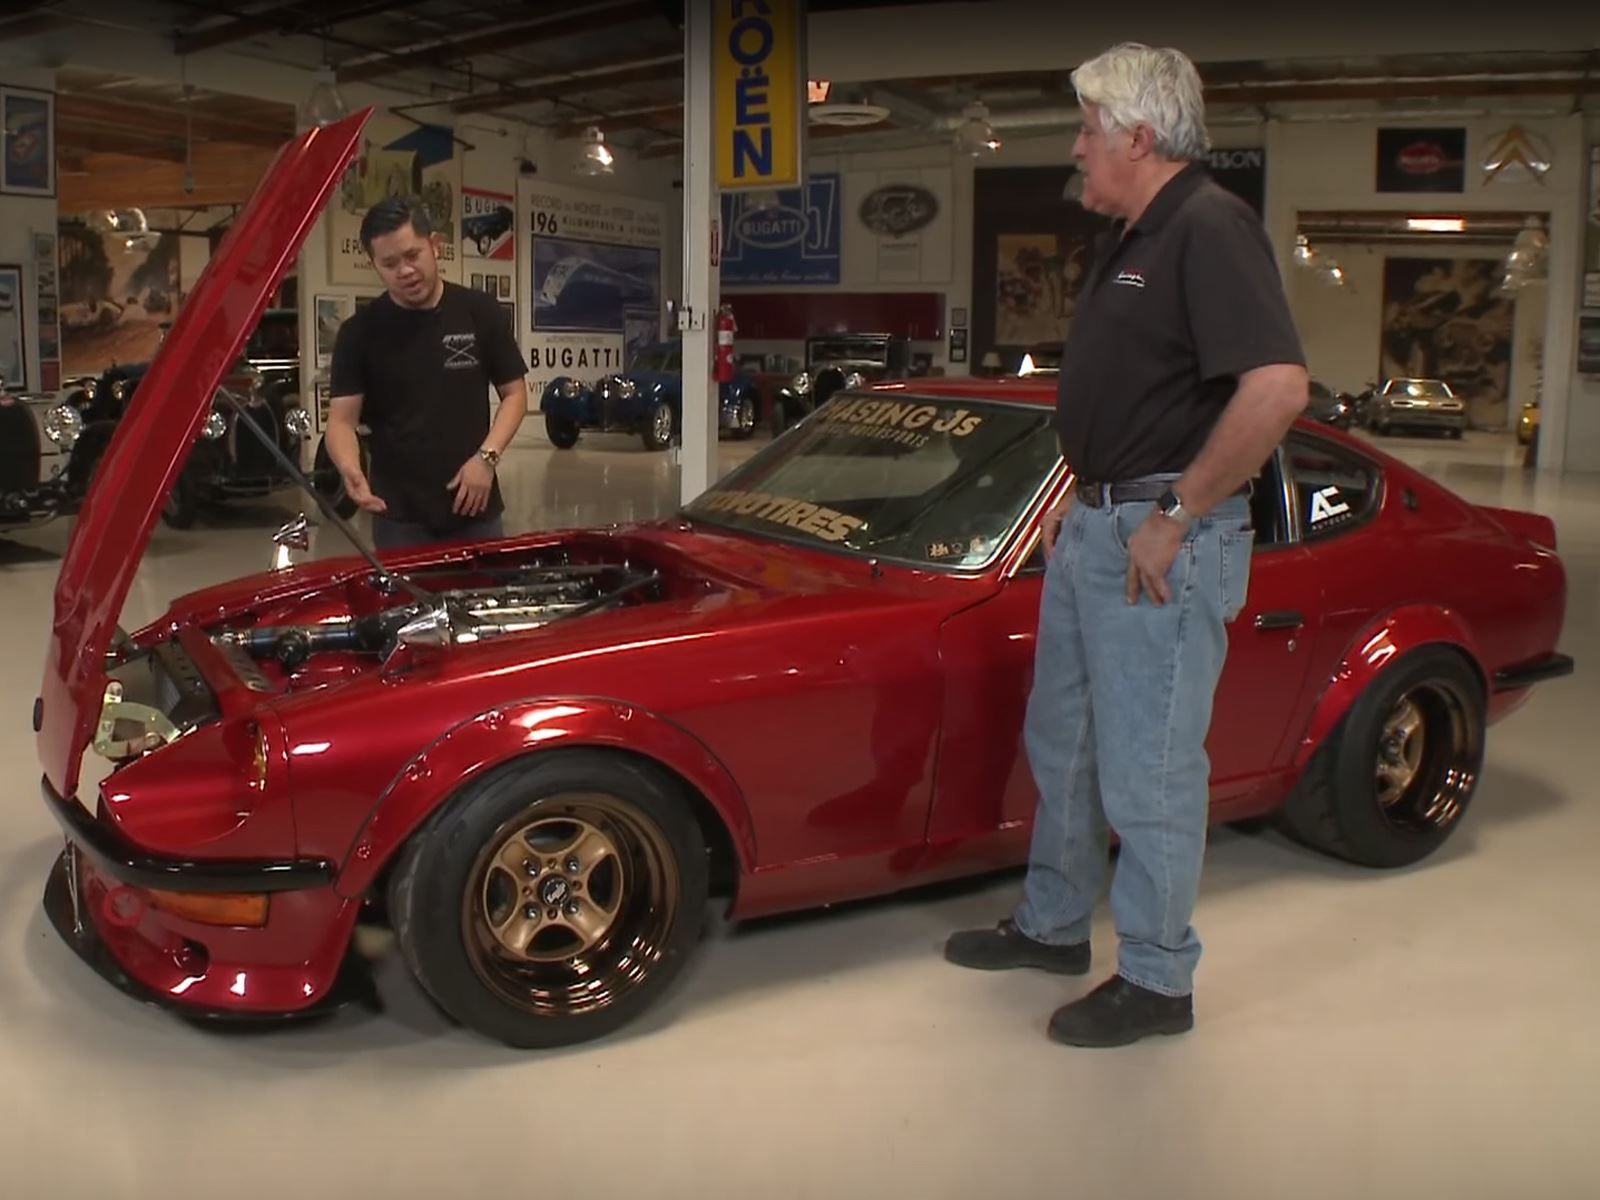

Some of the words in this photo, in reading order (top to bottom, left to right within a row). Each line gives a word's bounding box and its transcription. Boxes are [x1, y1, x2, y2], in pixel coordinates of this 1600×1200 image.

[530, 210, 558, 234] 196
[743, 219, 800, 235] BUGATTI
[530, 347, 620, 368] BUGATTI
